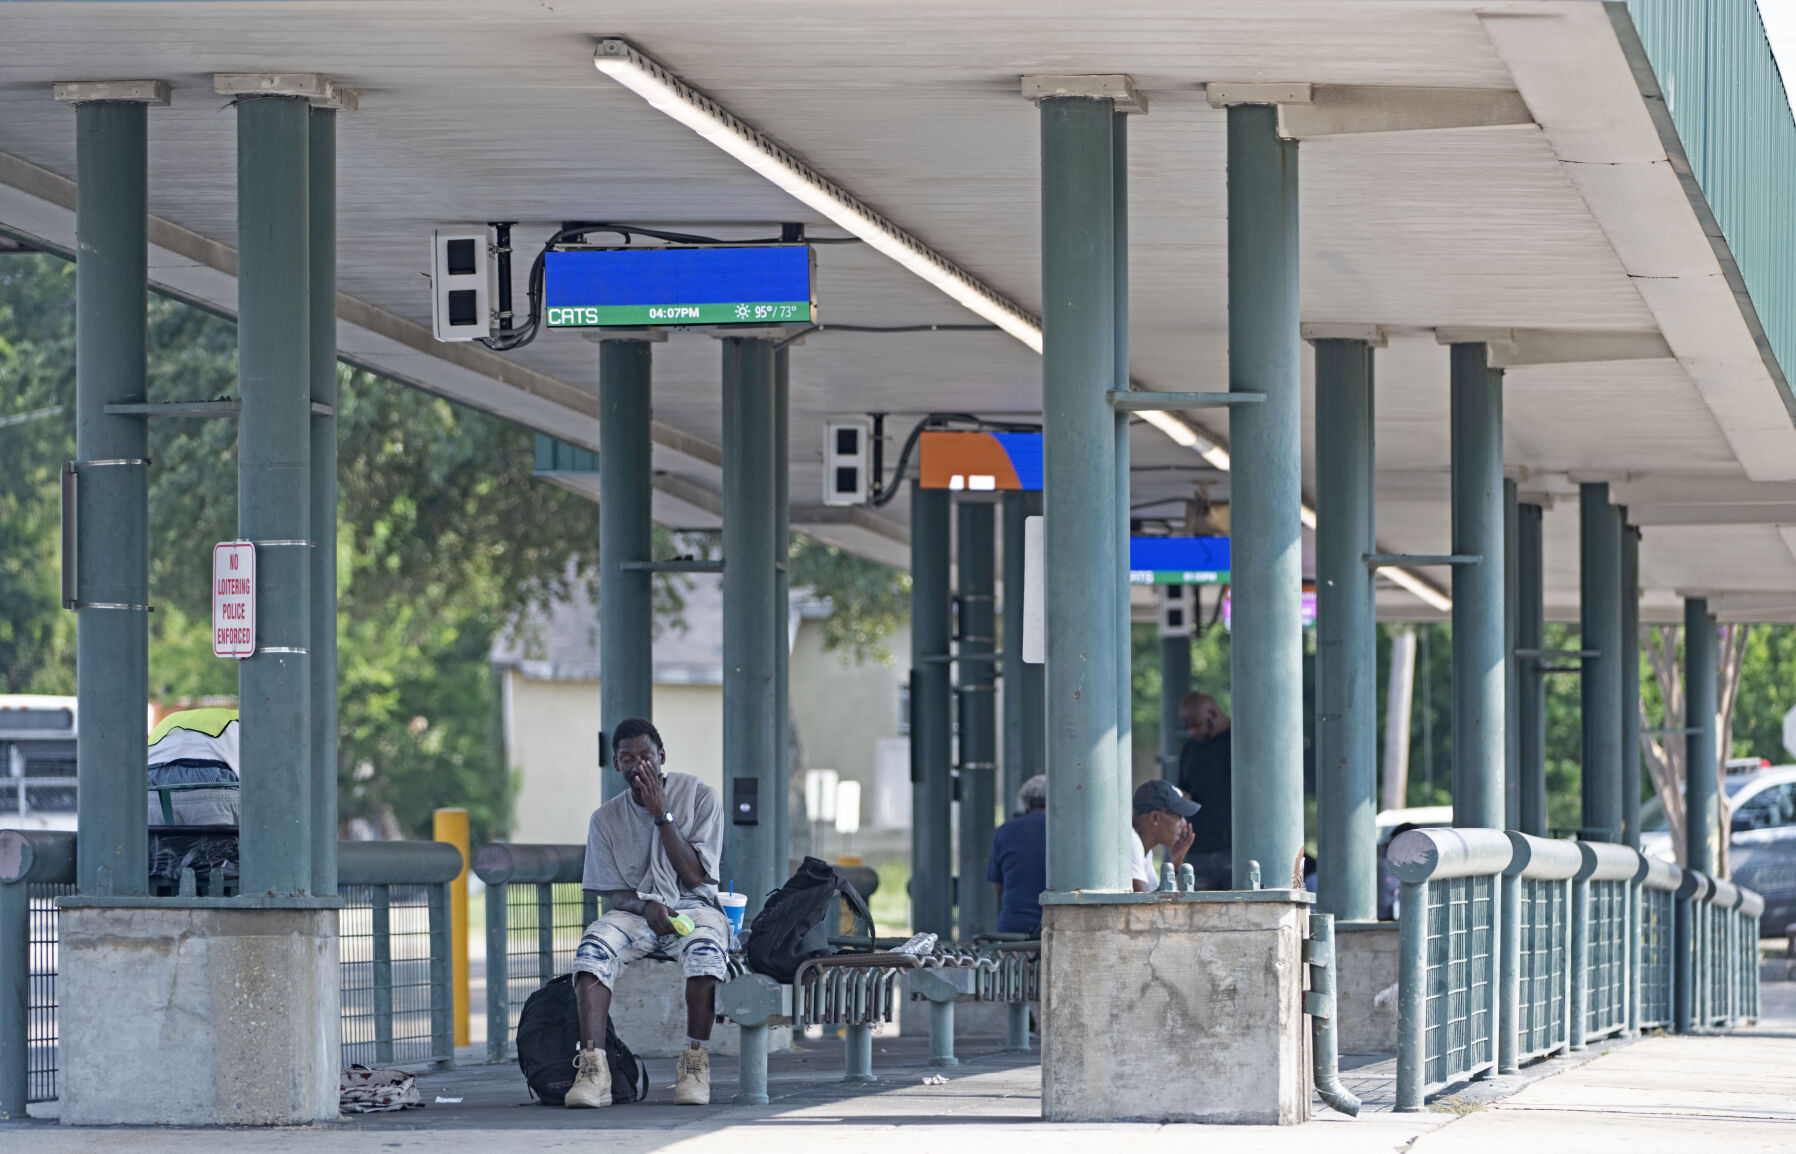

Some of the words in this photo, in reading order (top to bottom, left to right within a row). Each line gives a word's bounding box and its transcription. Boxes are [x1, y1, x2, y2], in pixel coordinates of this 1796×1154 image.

[548, 308, 599, 325] CATS
[649, 307, 700, 319] 04:07PM
[229, 553, 239, 570] NO
[217, 578, 250, 595] LOITERING
[222, 603, 246, 620] POLICE
[217, 628, 251, 645] ENFORCED
